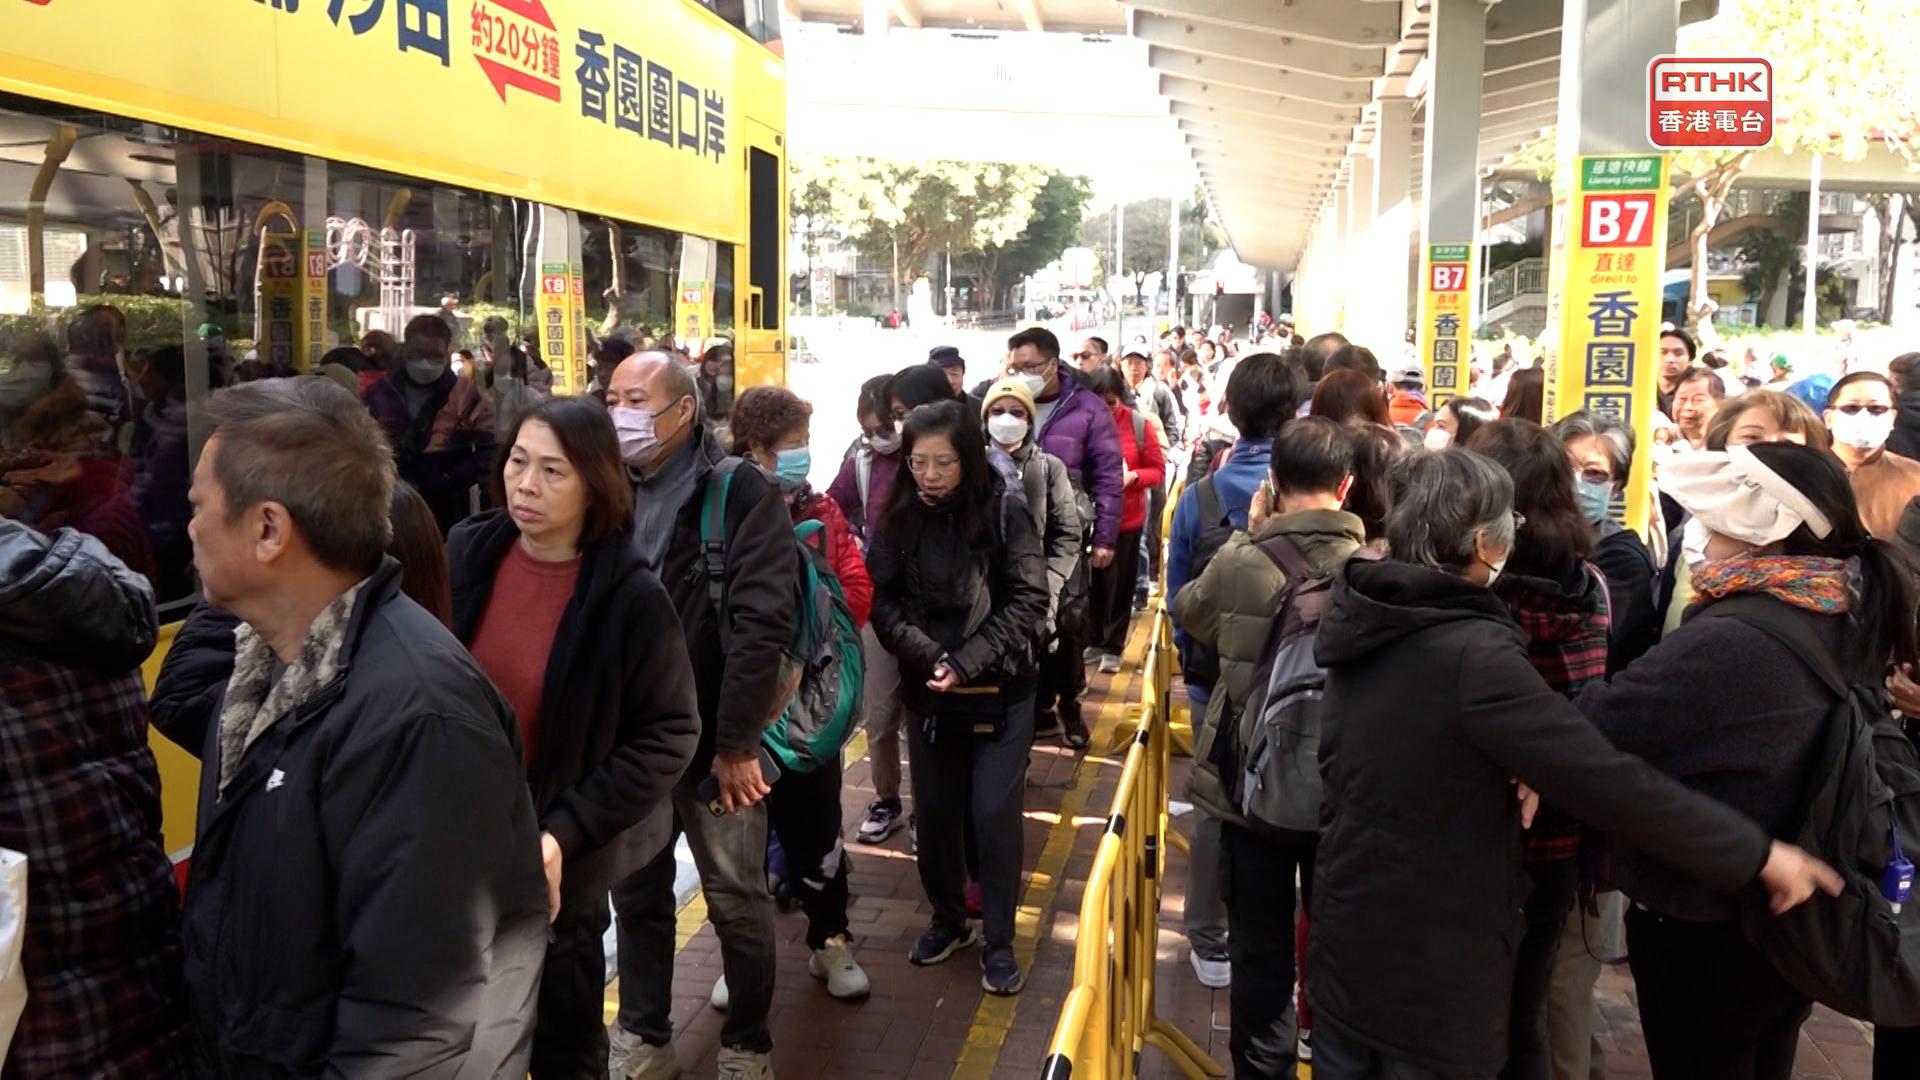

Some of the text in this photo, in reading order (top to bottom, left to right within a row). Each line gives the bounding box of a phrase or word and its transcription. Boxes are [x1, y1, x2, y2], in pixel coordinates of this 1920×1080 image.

[471, 2, 560, 80] 約20分鐘
[575, 28, 726, 164] 香園圍口岸
[1588, 199, 1649, 243] B7
[1433, 266, 1465, 290] B7
[1595, 251, 1636, 272] 直達
[1590, 274, 1638, 284] direct to
